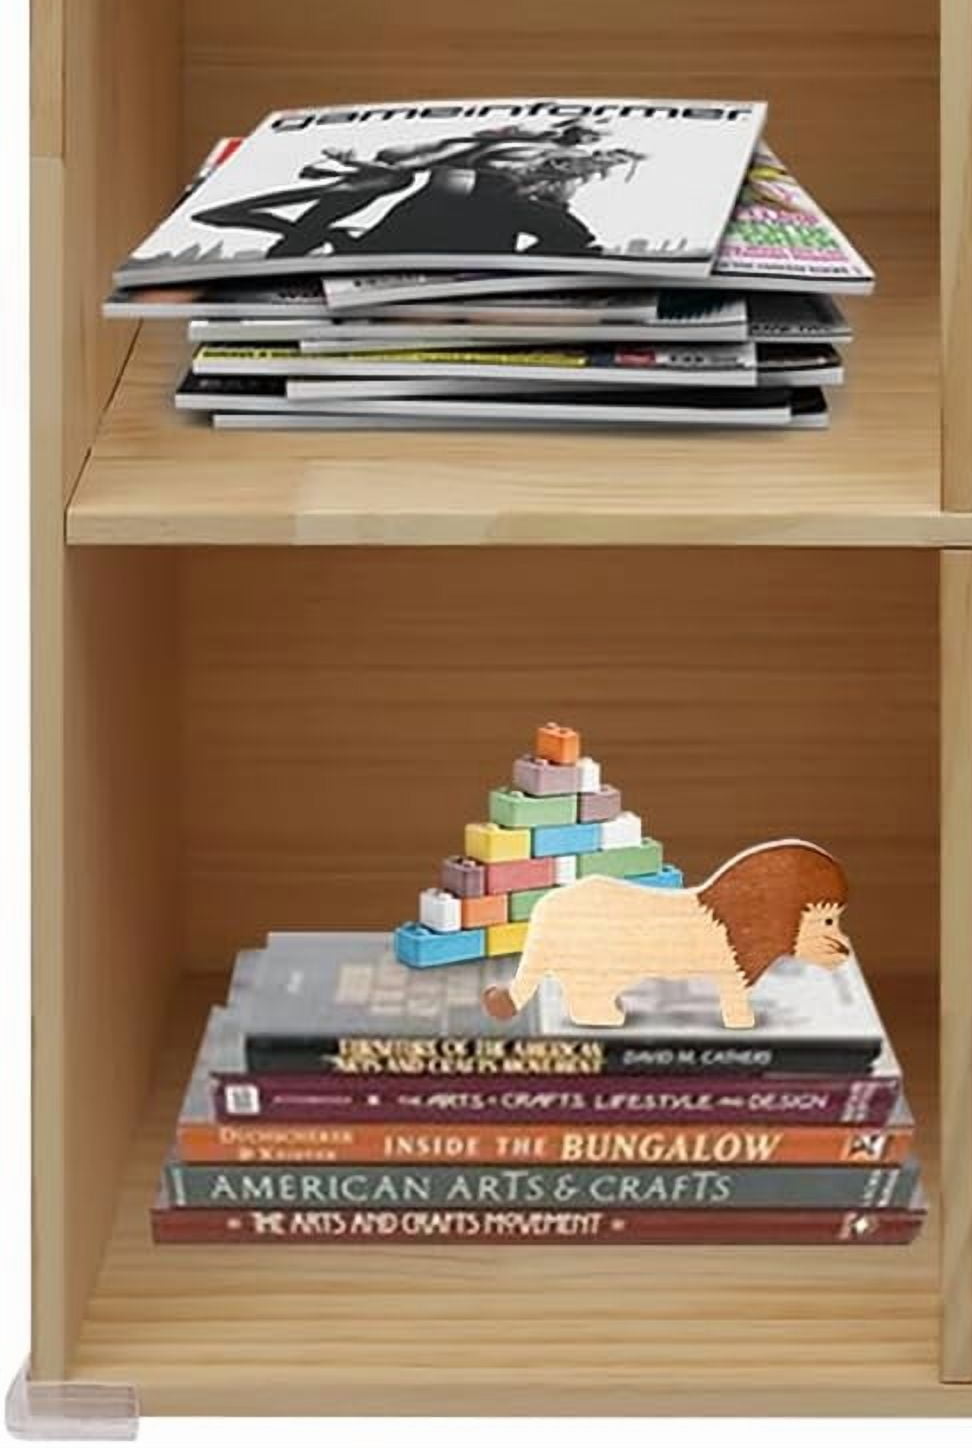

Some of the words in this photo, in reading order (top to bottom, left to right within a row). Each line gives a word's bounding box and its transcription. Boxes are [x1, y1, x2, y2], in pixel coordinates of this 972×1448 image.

[623, 1049, 674, 1065] DAVID
[427, 1092, 484, 1109] ARTS
[501, 1092, 585, 1110] CRAFTS
[594, 1092, 713, 1110] LIFESTYLE
[748, 1092, 829, 1110] DESIGN
[384, 1136, 480, 1158] INSIDE
[495, 1136, 547, 1157] THE
[561, 1131, 785, 1162] BUNGALOW
[210, 1174, 433, 1202] AMERICAN
[447, 1169, 544, 1202] ARTS
[554, 1174, 579, 1201] &
[589, 1169, 732, 1203] CRAFTS
[252, 1211, 285, 1234] THE
[290, 1211, 346, 1234] ARTS
[350, 1211, 399, 1234] AND
[401, 1211, 480, 1235] CRAFTS
[483, 1212, 601, 1237] MOVEMENT
